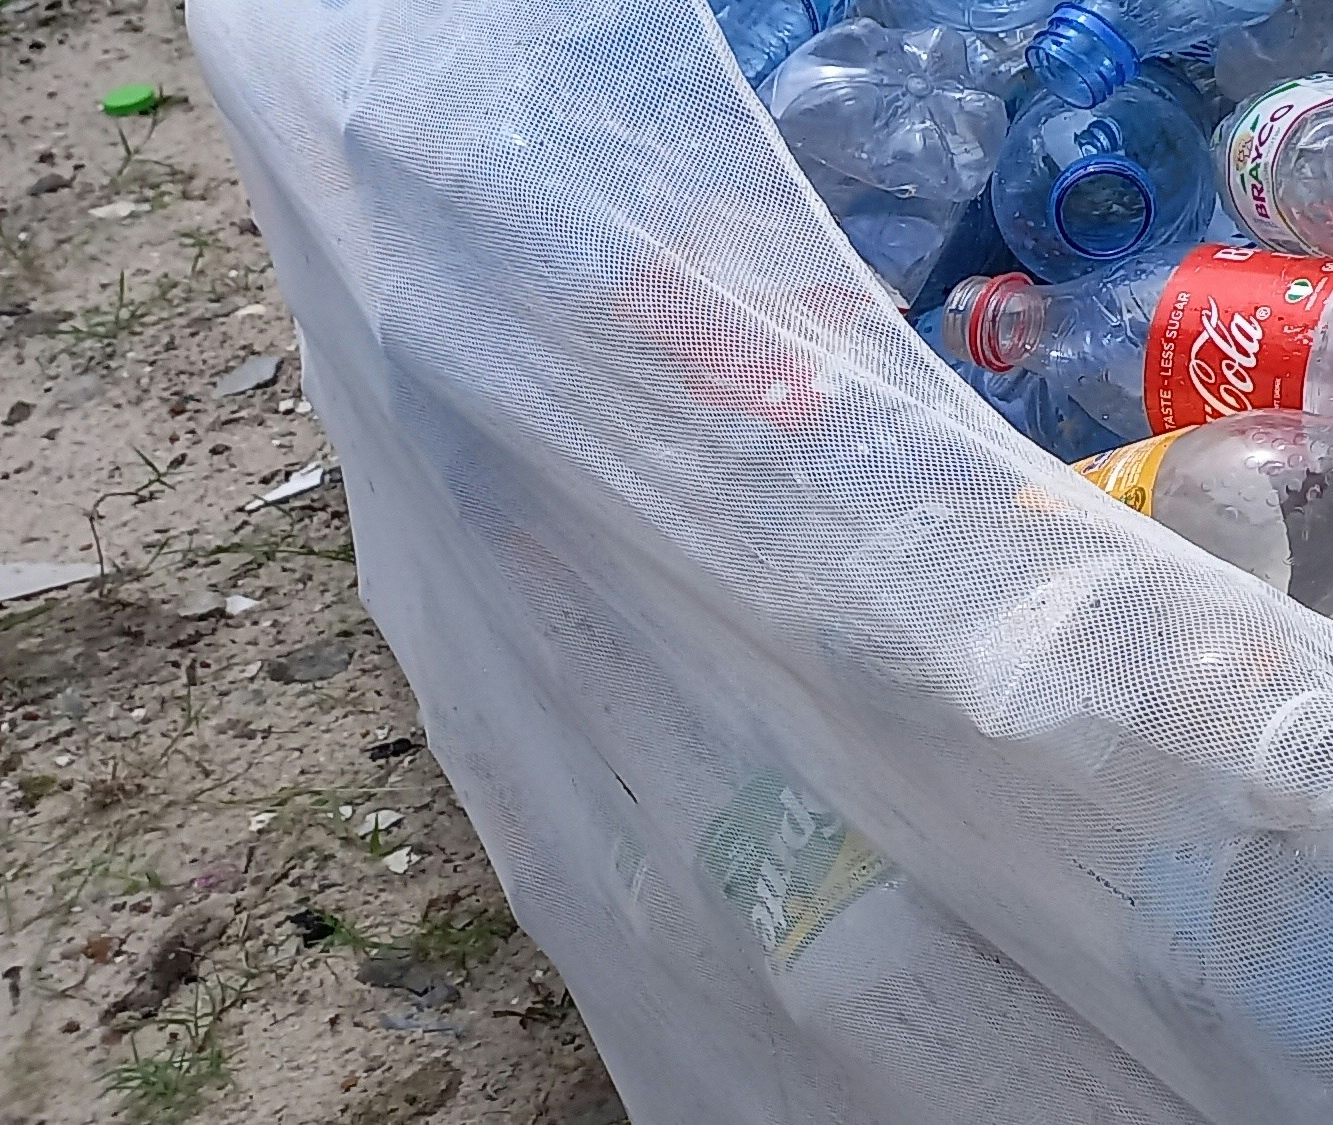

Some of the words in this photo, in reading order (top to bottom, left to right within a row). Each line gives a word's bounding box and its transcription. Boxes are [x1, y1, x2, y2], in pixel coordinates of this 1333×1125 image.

[1248, 103, 1295, 220] BRAYCO
[1165, 291, 1191, 339] SUGAR
[1159, 341, 1176, 377] LESS
[1159, 388, 1177, 430] TASTE
